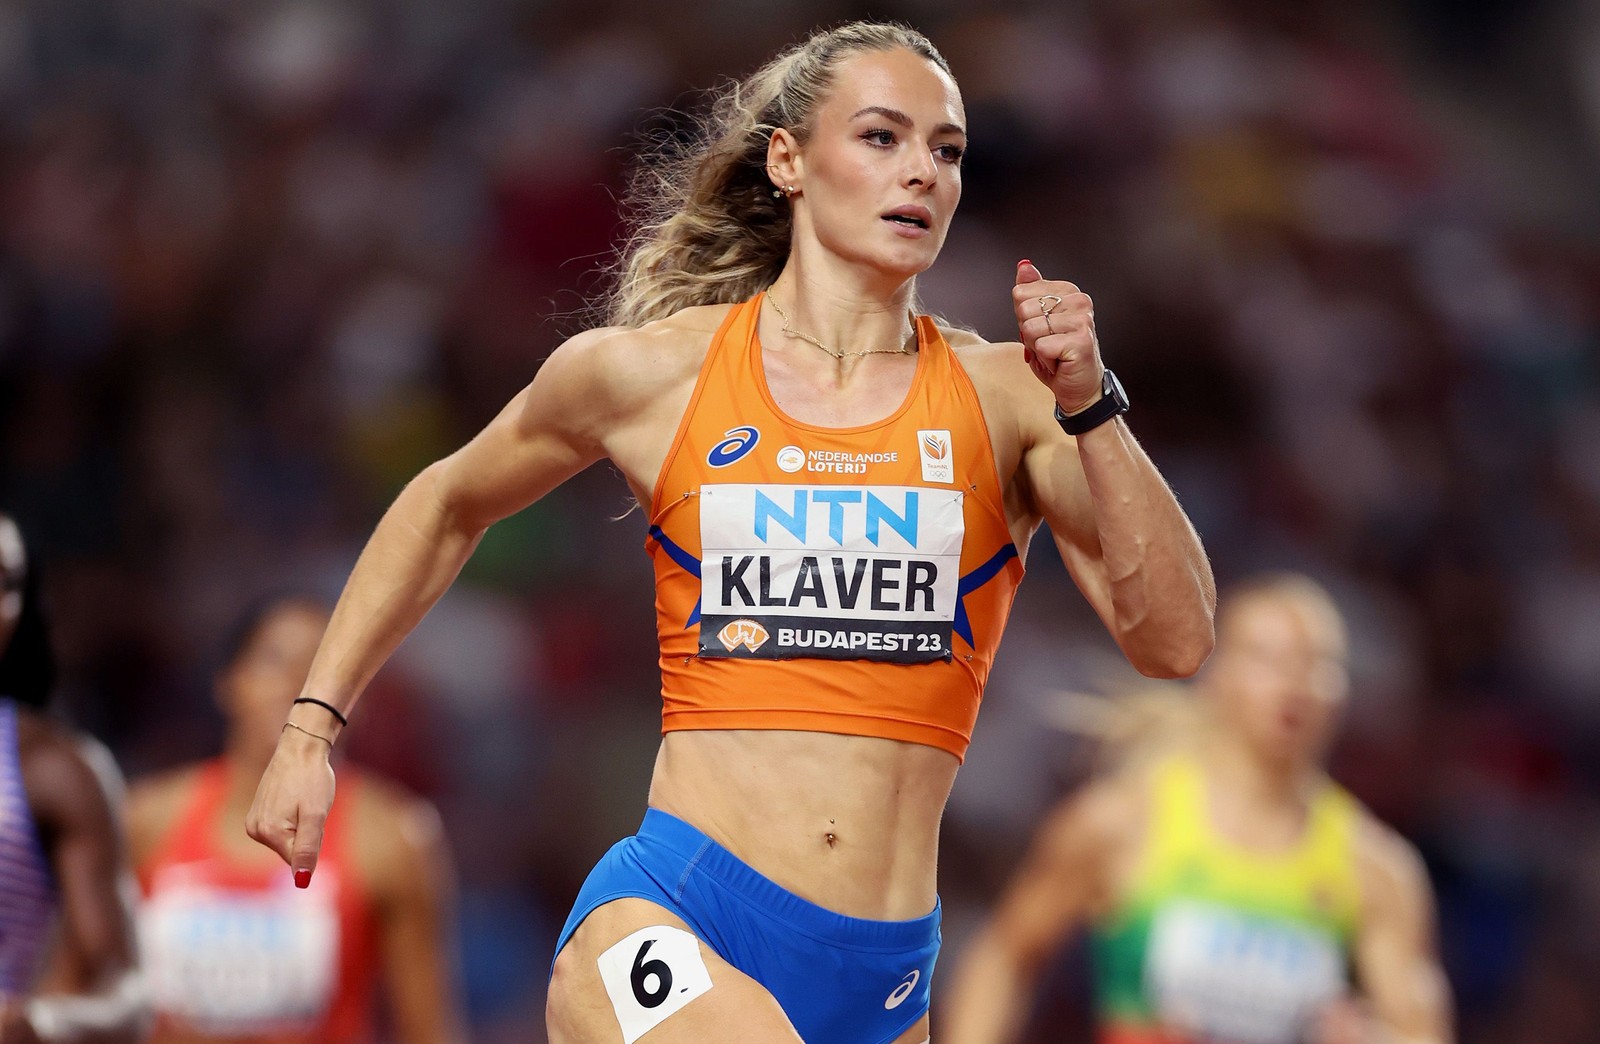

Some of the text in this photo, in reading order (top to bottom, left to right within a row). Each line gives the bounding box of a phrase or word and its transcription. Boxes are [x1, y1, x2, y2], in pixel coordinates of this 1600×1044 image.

[807, 463, 867, 474] LOTERIJ
[808, 450, 898, 463] NEDERLANDSE
[754, 489, 919, 549] NTN
[720, 555, 938, 612] KLAVER
[777, 628, 942, 651] BUDAPEST 23
[630, 939, 673, 1009] 6
